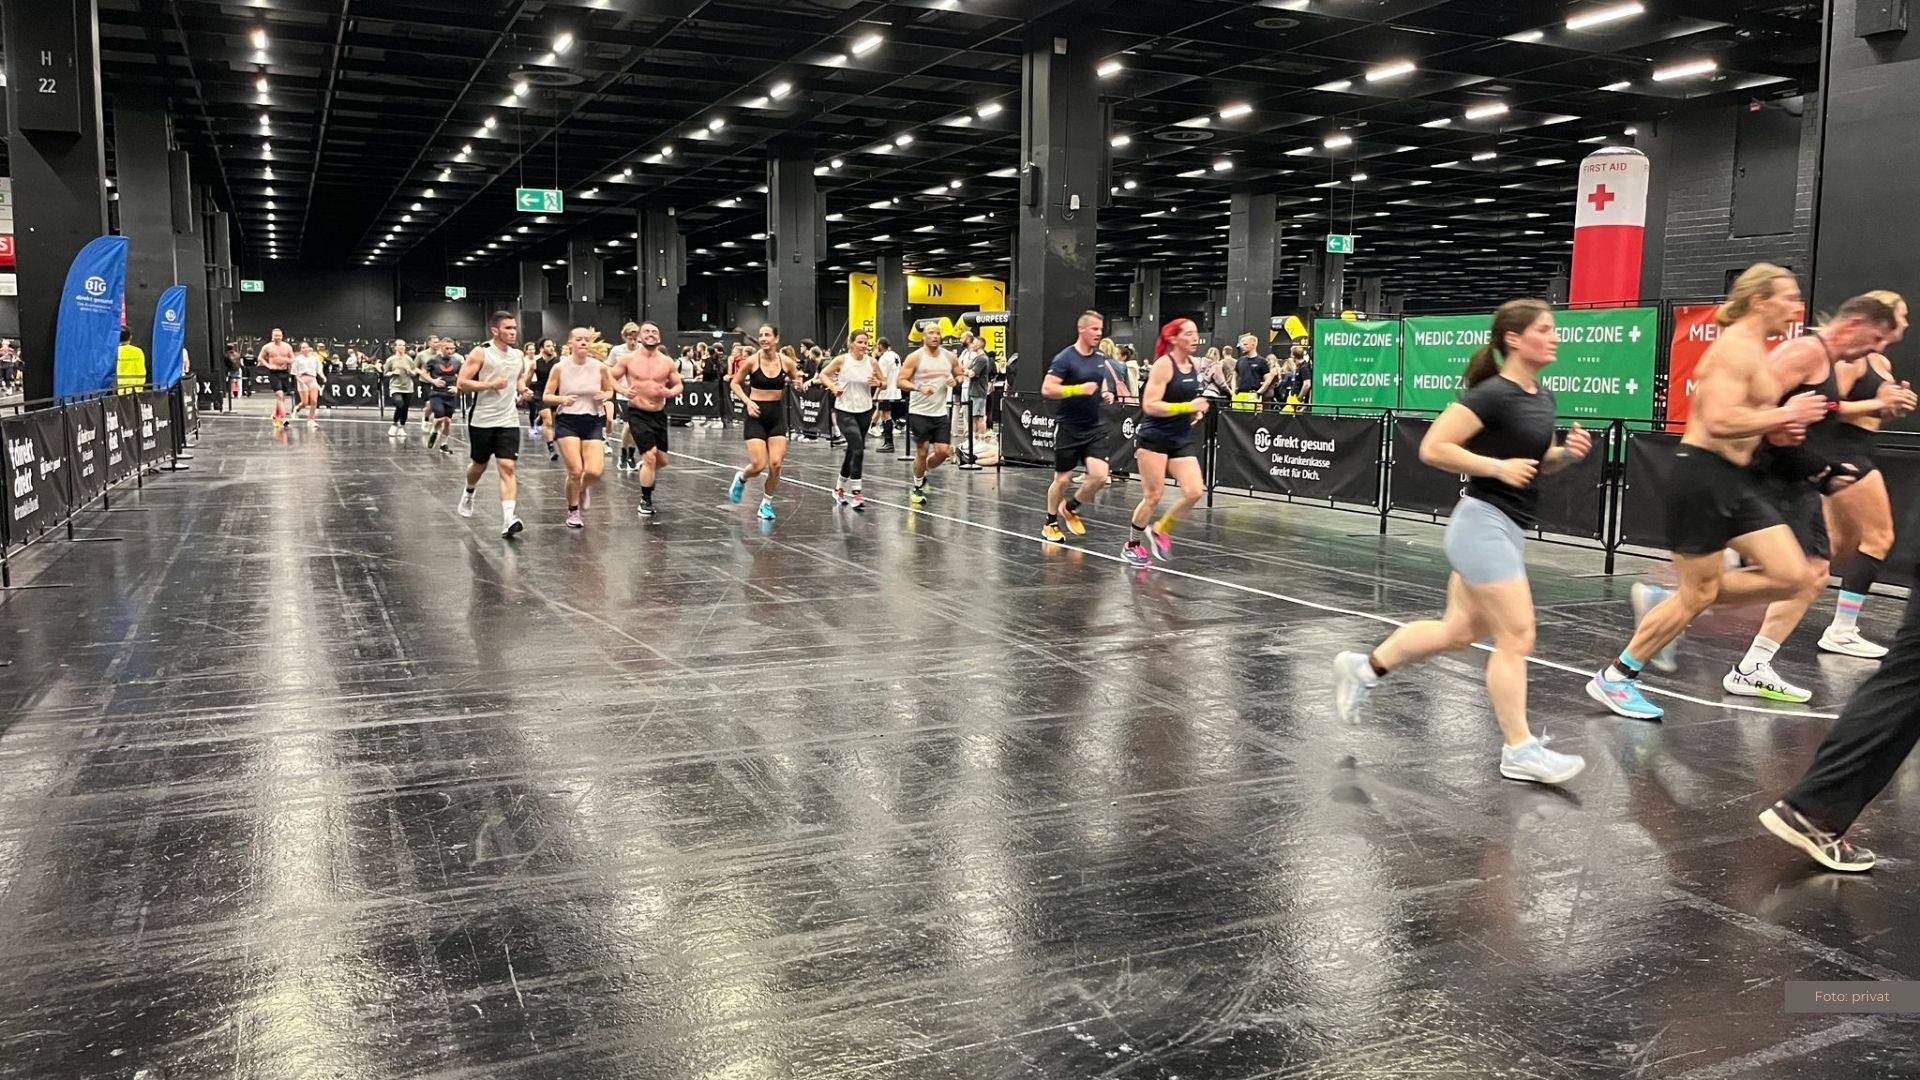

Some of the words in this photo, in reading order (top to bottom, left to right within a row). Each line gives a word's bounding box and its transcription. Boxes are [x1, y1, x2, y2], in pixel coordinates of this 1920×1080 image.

[41, 50, 52, 66] H
[39, 77, 57, 93] 22
[1583, 163, 1607, 174] FIRST
[1610, 162, 1628, 172] AID
[85, 278, 107, 293] BIG
[927, 283, 943, 297] IN
[975, 313, 1009, 324] BURPEES
[1324, 332, 1361, 347] MEDIC
[1362, 333, 1393, 347] ZONE
[1415, 330, 1454, 346] MEDIC
[1456, 330, 1492, 345] ZONE
[1554, 327, 1584, 343] EDIC
[1585, 326, 1624, 343] ZONE
[1322, 373, 1358, 387] MEDIC
[1360, 373, 1391, 387] ZONE
[1413, 374, 1452, 390] MEDIC
[1542, 375, 1581, 393] MEDIC
[1583, 376, 1621, 394] ZONE
[317, 384, 372, 398] YROX
[1254, 430, 1271, 449] BIG
[1273, 434, 1299, 448] direkt
[1300, 439, 1335, 452] gesund
[1271, 452, 1283, 464] Die
[1283, 454, 1331, 468] Krankenkasse
[1269, 465, 1290, 477] direkt
[1291, 467, 1301, 478] für
[1301, 469, 1320, 481] Dich.
